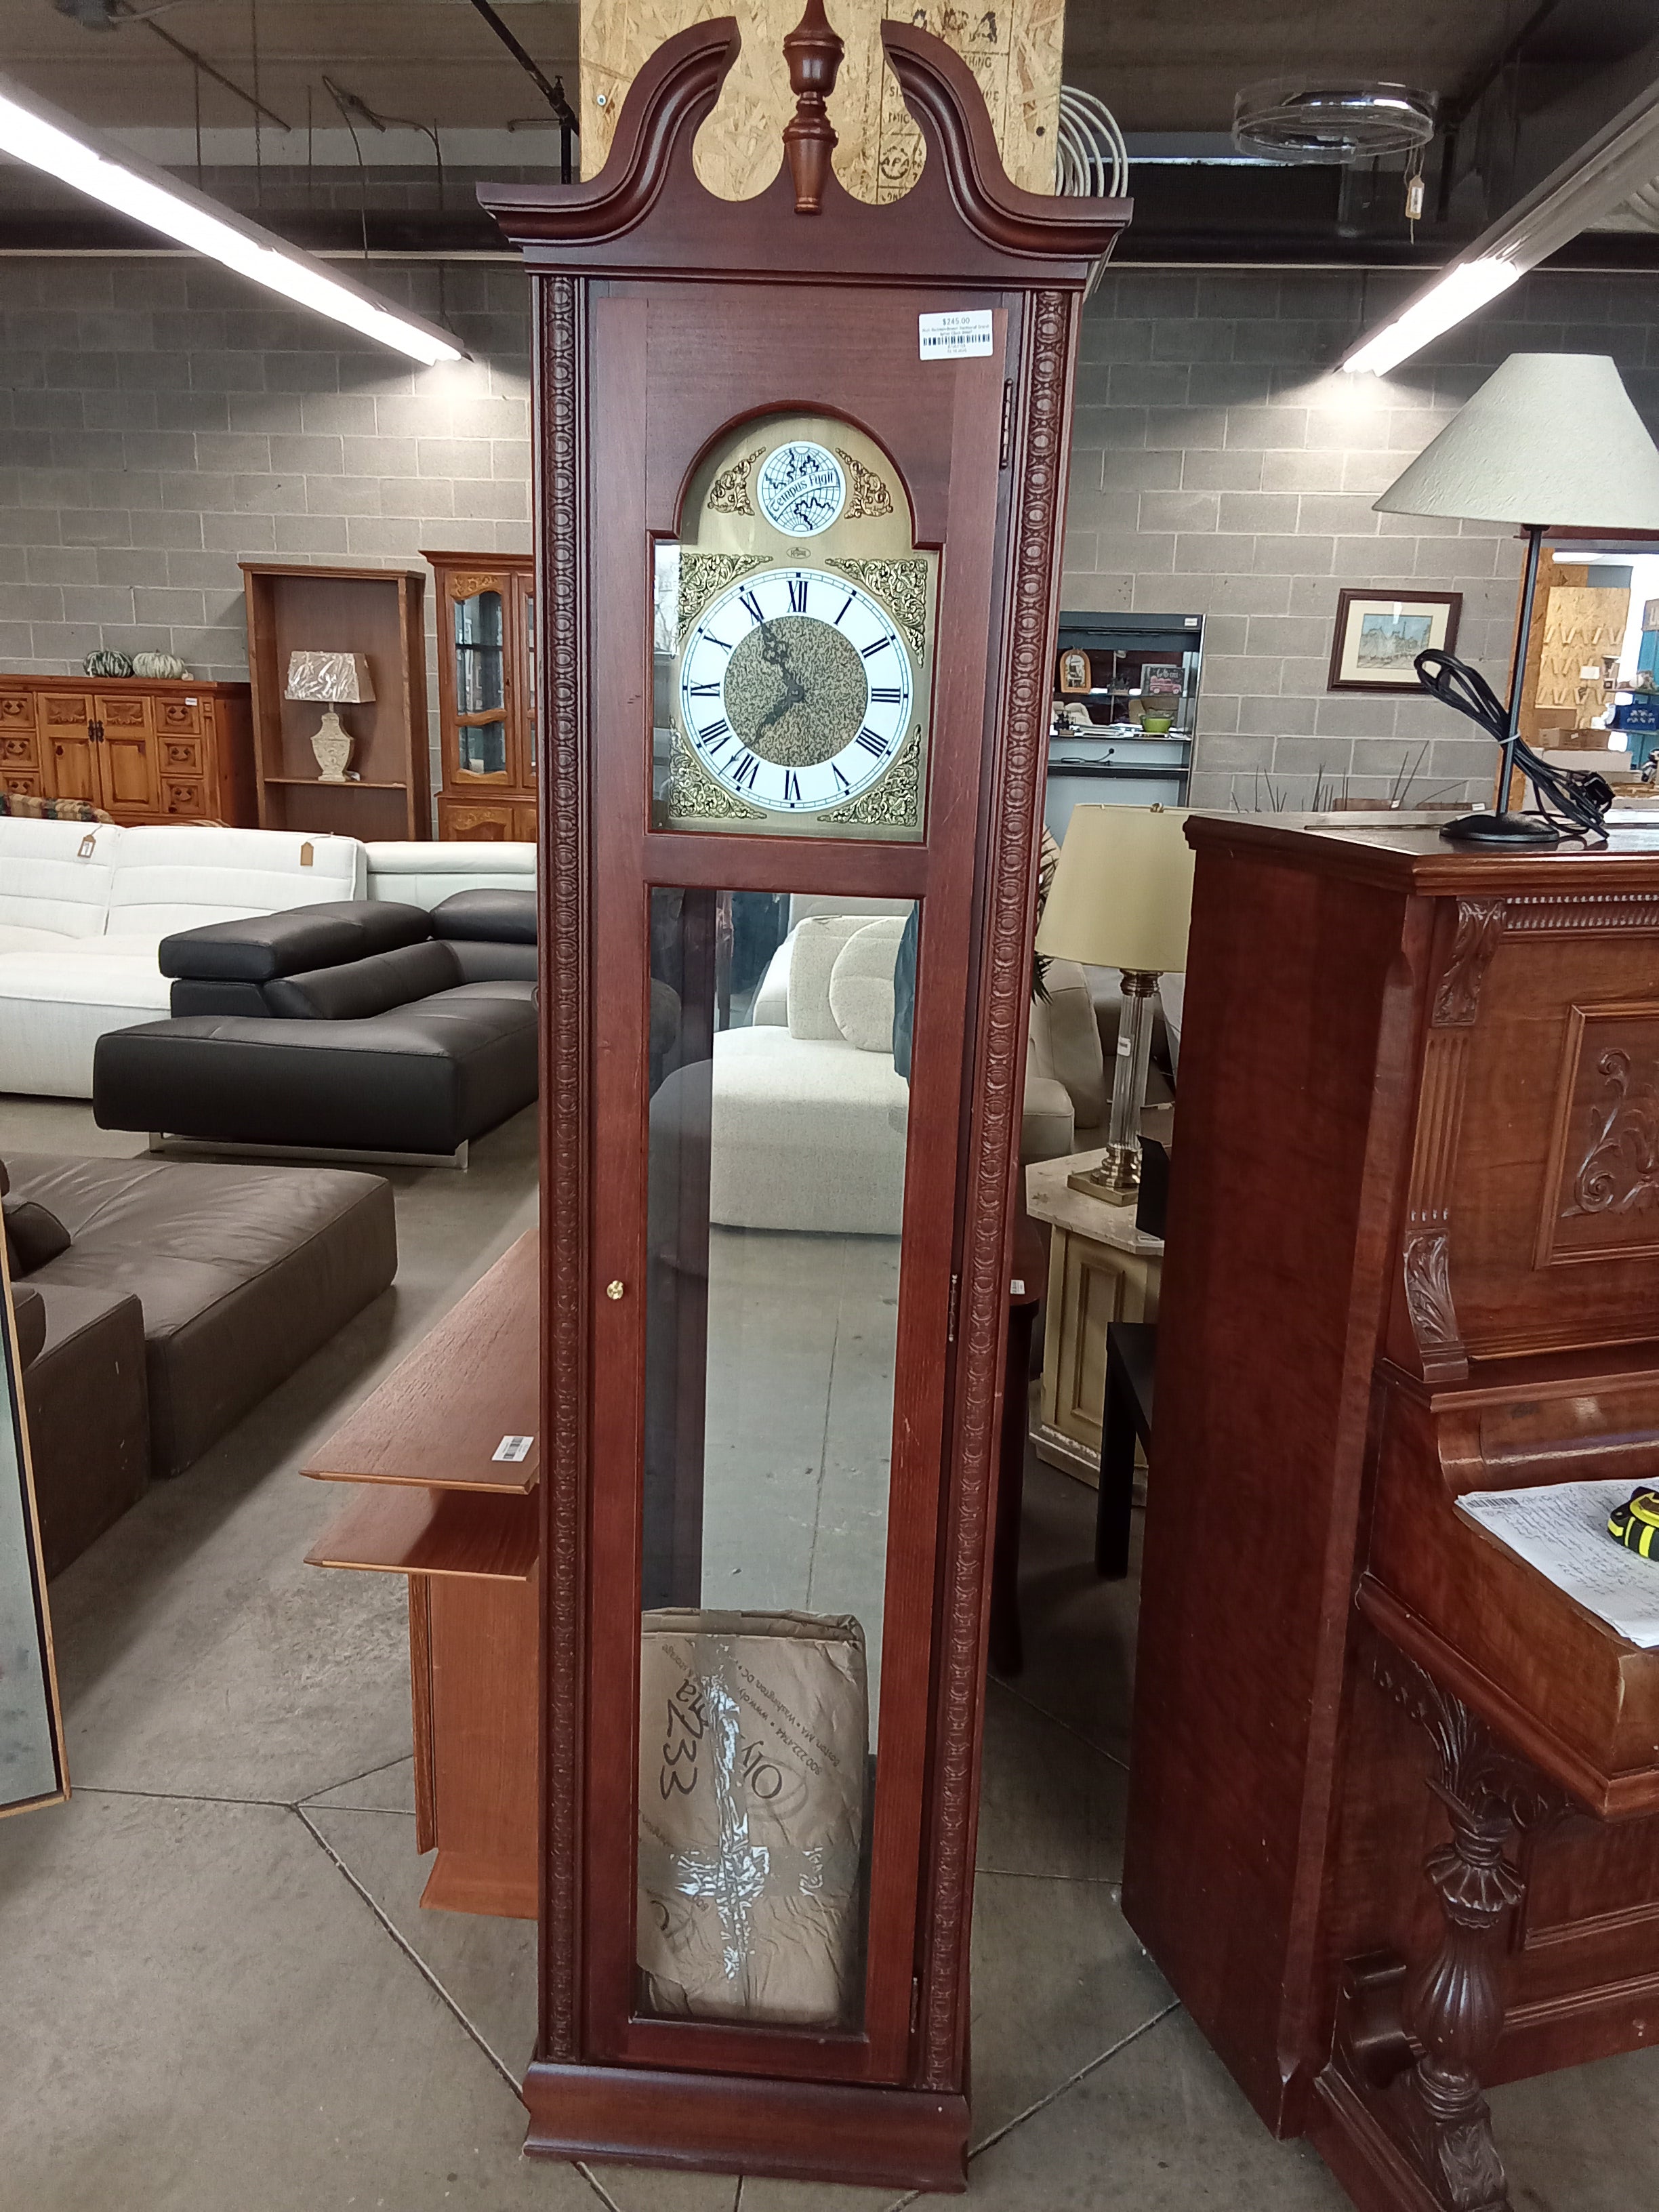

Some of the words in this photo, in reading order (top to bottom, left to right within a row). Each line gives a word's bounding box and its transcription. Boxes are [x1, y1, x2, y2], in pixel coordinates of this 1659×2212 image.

[770, 480, 808, 512] Tempus
[809, 471, 833, 487] Fugit
[739, 590, 764, 626] XI
[787, 581, 808, 613] XII
[703, 629, 733, 655] X
[860, 635, 890, 659] II
[690, 680, 720, 697] IX
[871, 686, 901, 705] III
[699, 718, 733, 755] VIII
[856, 726, 890, 758] IIII
[733, 752, 760, 790] VII
[784, 770, 801, 801] VI
[831, 762, 851, 791] V
[741, 1668, 755, 1683] DC
[660, 1699, 706, 1800] 233
[801, 1726, 815, 1743] MA
[805, 1758, 822, 1775] 800
